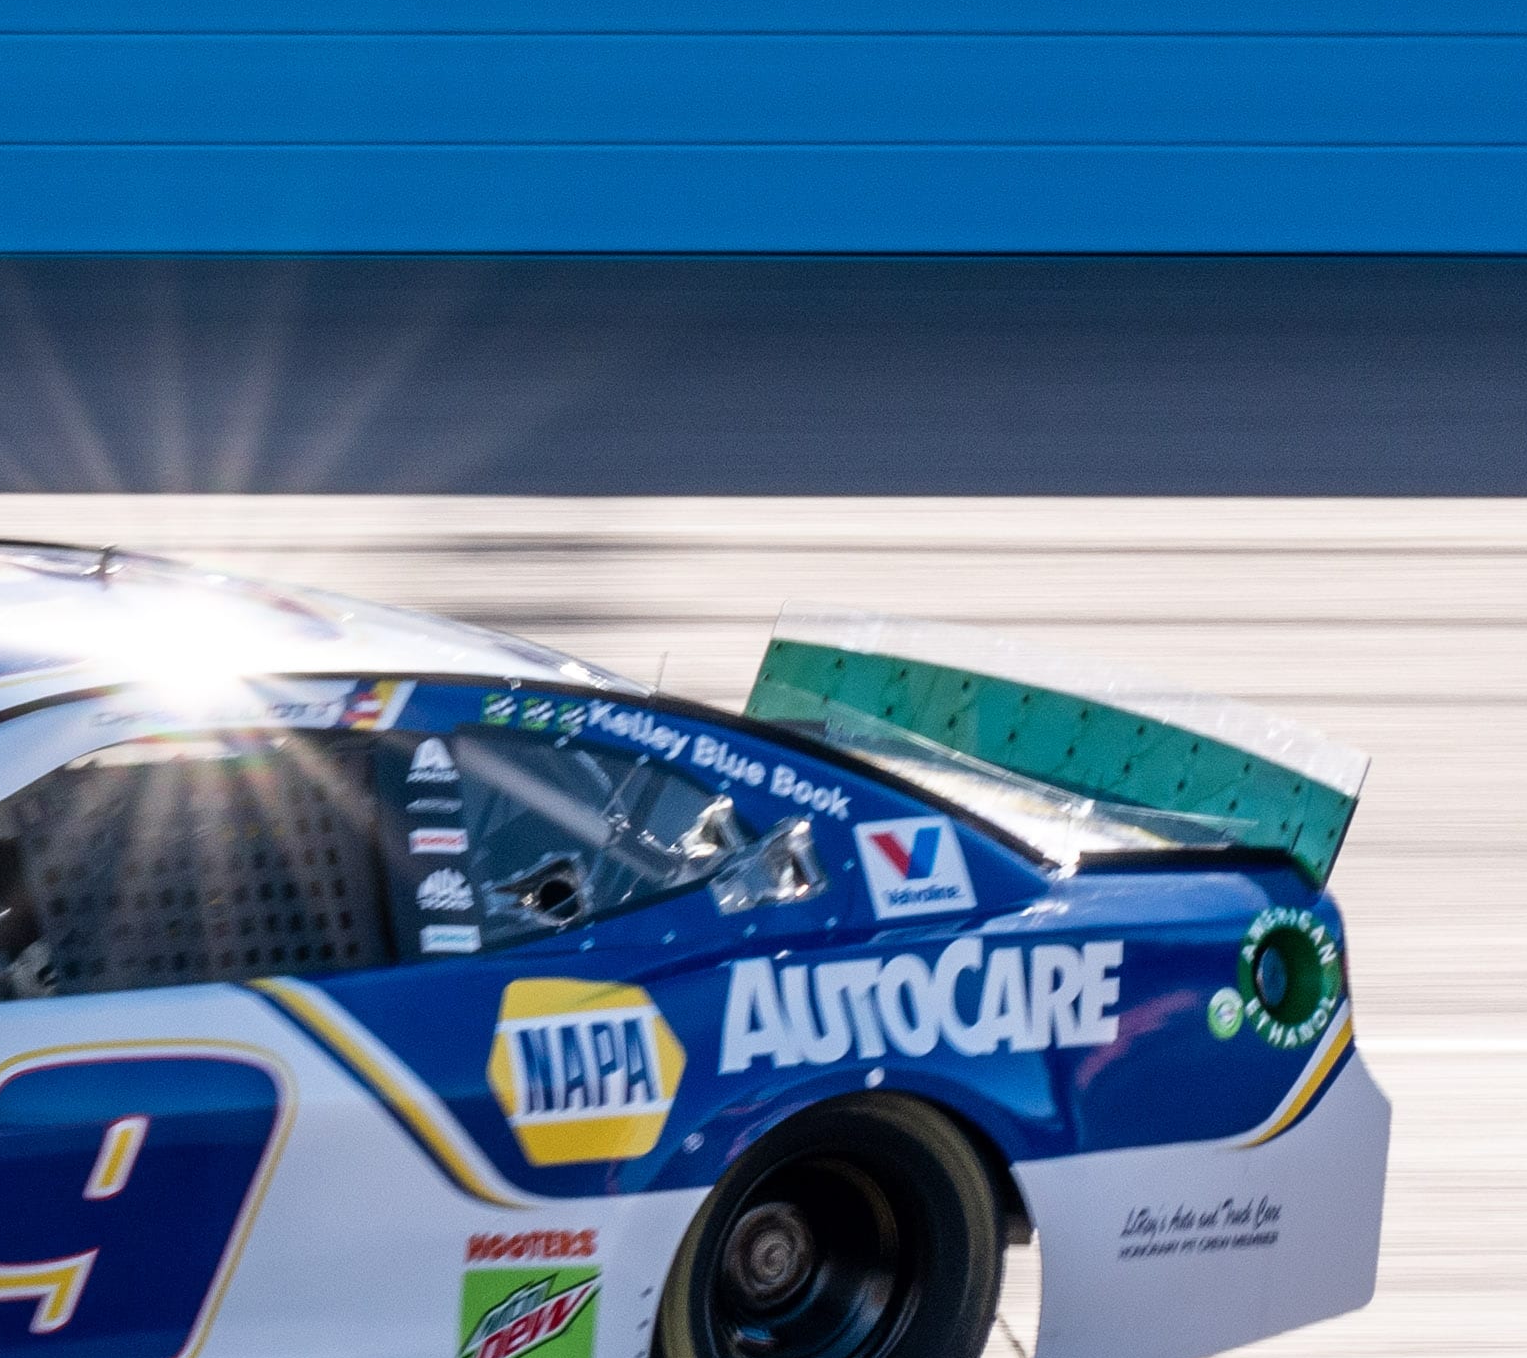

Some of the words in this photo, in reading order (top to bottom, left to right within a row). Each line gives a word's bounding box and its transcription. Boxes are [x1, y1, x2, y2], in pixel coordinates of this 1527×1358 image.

[585, 699, 690, 760] Kelley
[692, 734, 766, 787] Blue
[770, 763, 851, 821] Book
[1242, 906, 1337, 966] AMERICAN
[718, 937, 1125, 1075] AUTOCARE
[1246, 996, 1336, 1049] ETHANOL
[517, 1015, 662, 1116] NAPA
